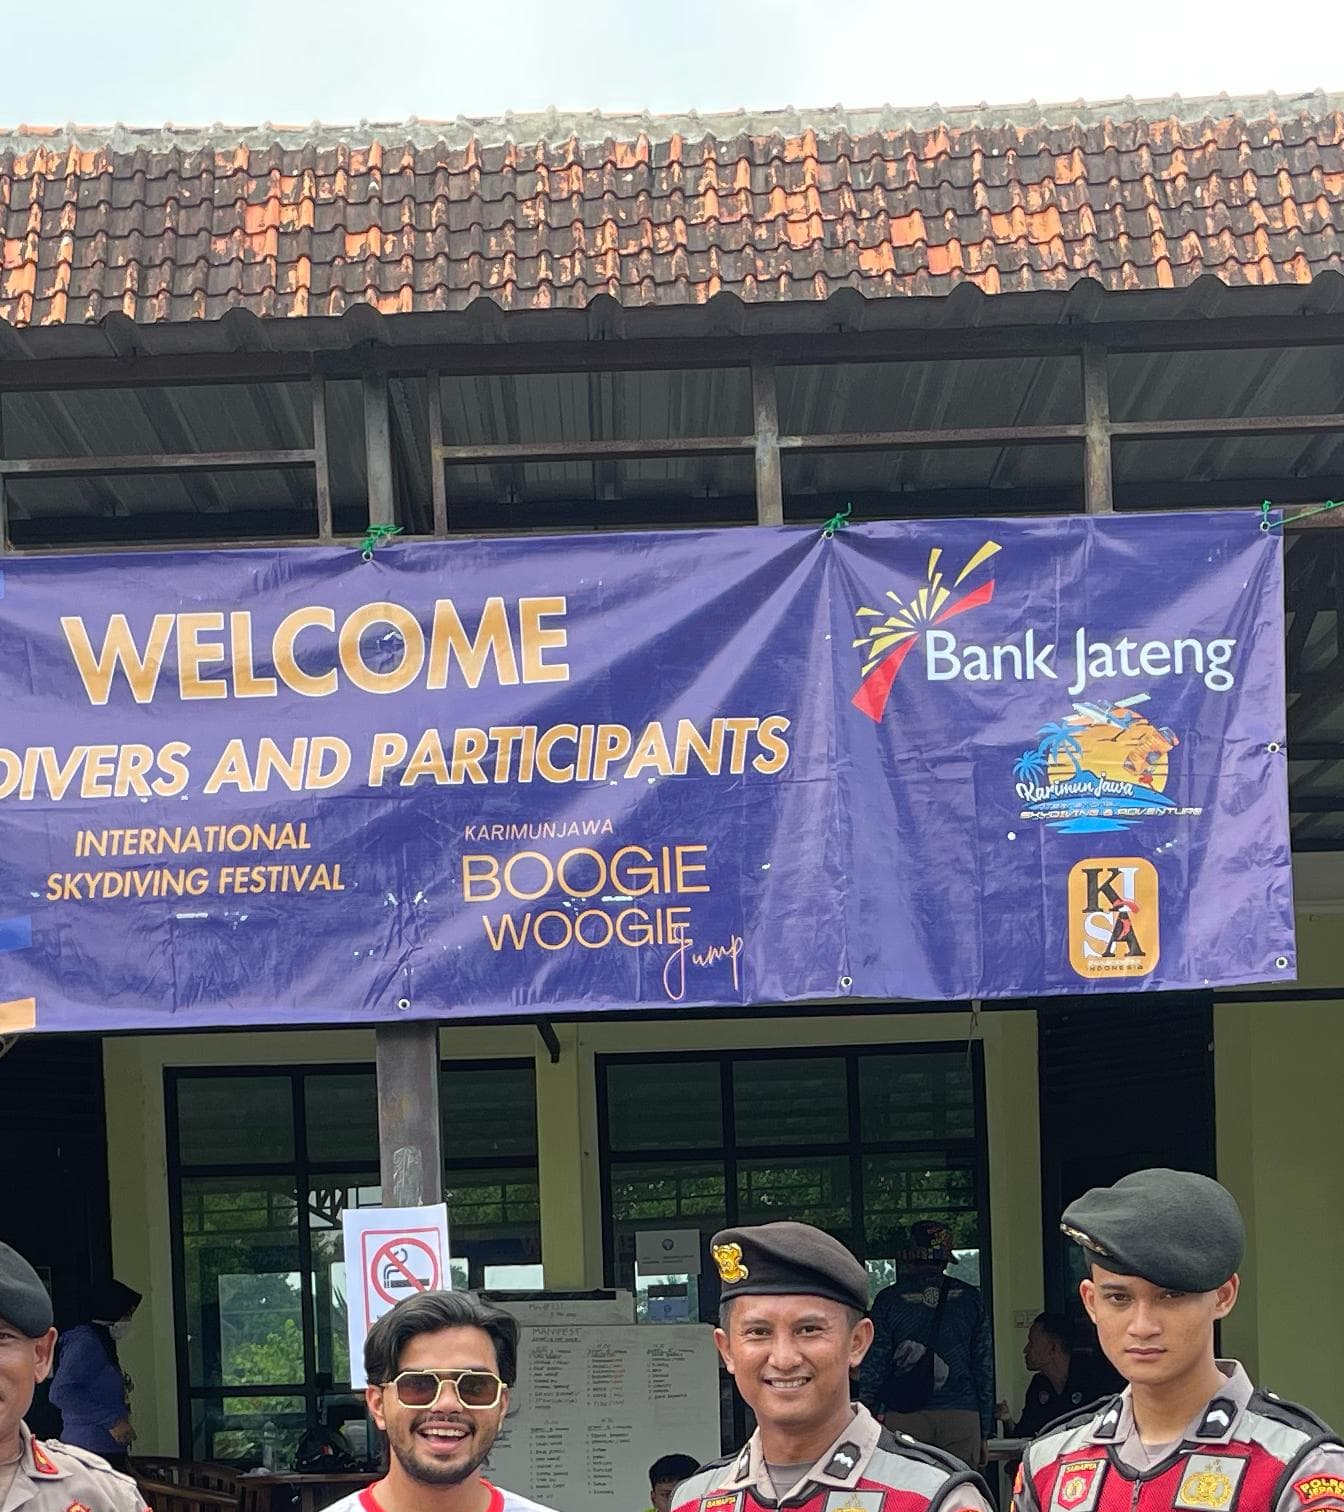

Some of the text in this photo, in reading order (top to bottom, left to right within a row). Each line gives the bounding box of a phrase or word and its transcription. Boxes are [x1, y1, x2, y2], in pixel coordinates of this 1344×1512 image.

[60, 595, 570, 706] WELCOME
[924, 624, 1238, 697] Bank Jateng
[202, 735, 353, 795] AND
[367, 715, 793, 788] PARTICIPANTS
[1015, 780, 1093, 803] Karimun
[74, 822, 312, 858] INTERNATIONAL
[464, 817, 615, 842] KARIMUNJAWA
[46, 863, 346, 902] SKYDIVING FESTIVAL
[461, 844, 711, 903] BOOGIE
[482, 905, 694, 951] WOOGIE
[662, 922, 745, 1001] Jump
